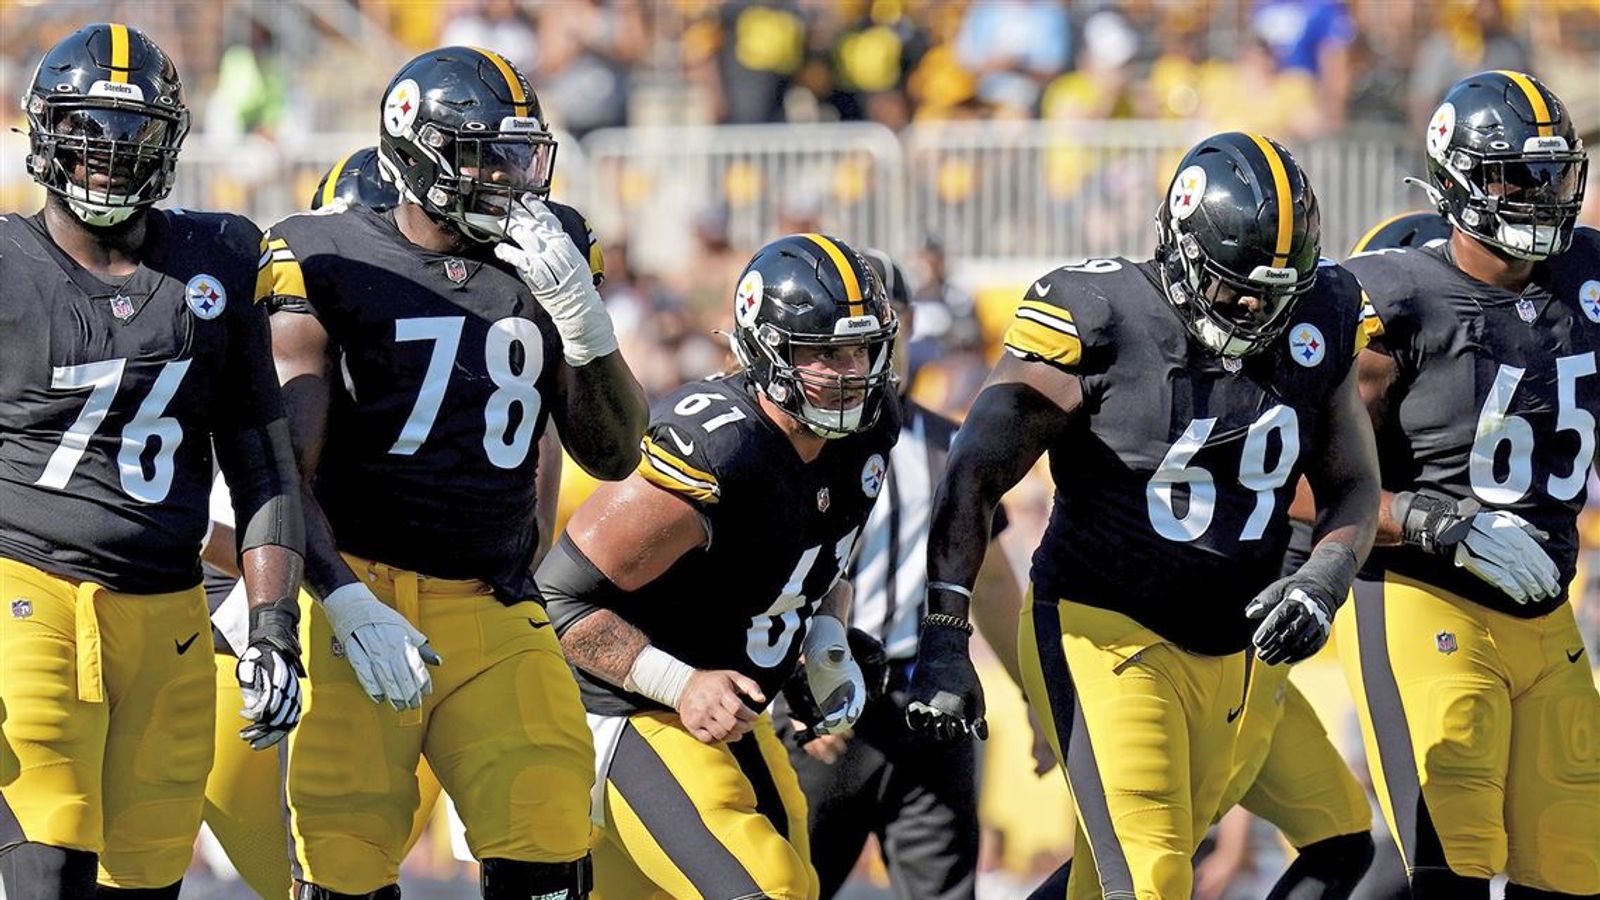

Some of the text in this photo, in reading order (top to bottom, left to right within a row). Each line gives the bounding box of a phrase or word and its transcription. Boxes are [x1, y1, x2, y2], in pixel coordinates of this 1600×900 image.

[104, 83, 131, 95] Steelers
[1265, 270, 1289, 279] Steelers
[848, 320, 871, 329] Steelers
[34, 358, 193, 503] 76
[388, 316, 544, 469] 78
[674, 393, 747, 433] 61
[1469, 351, 1597, 504] 65
[1146, 404, 1299, 541] 69
